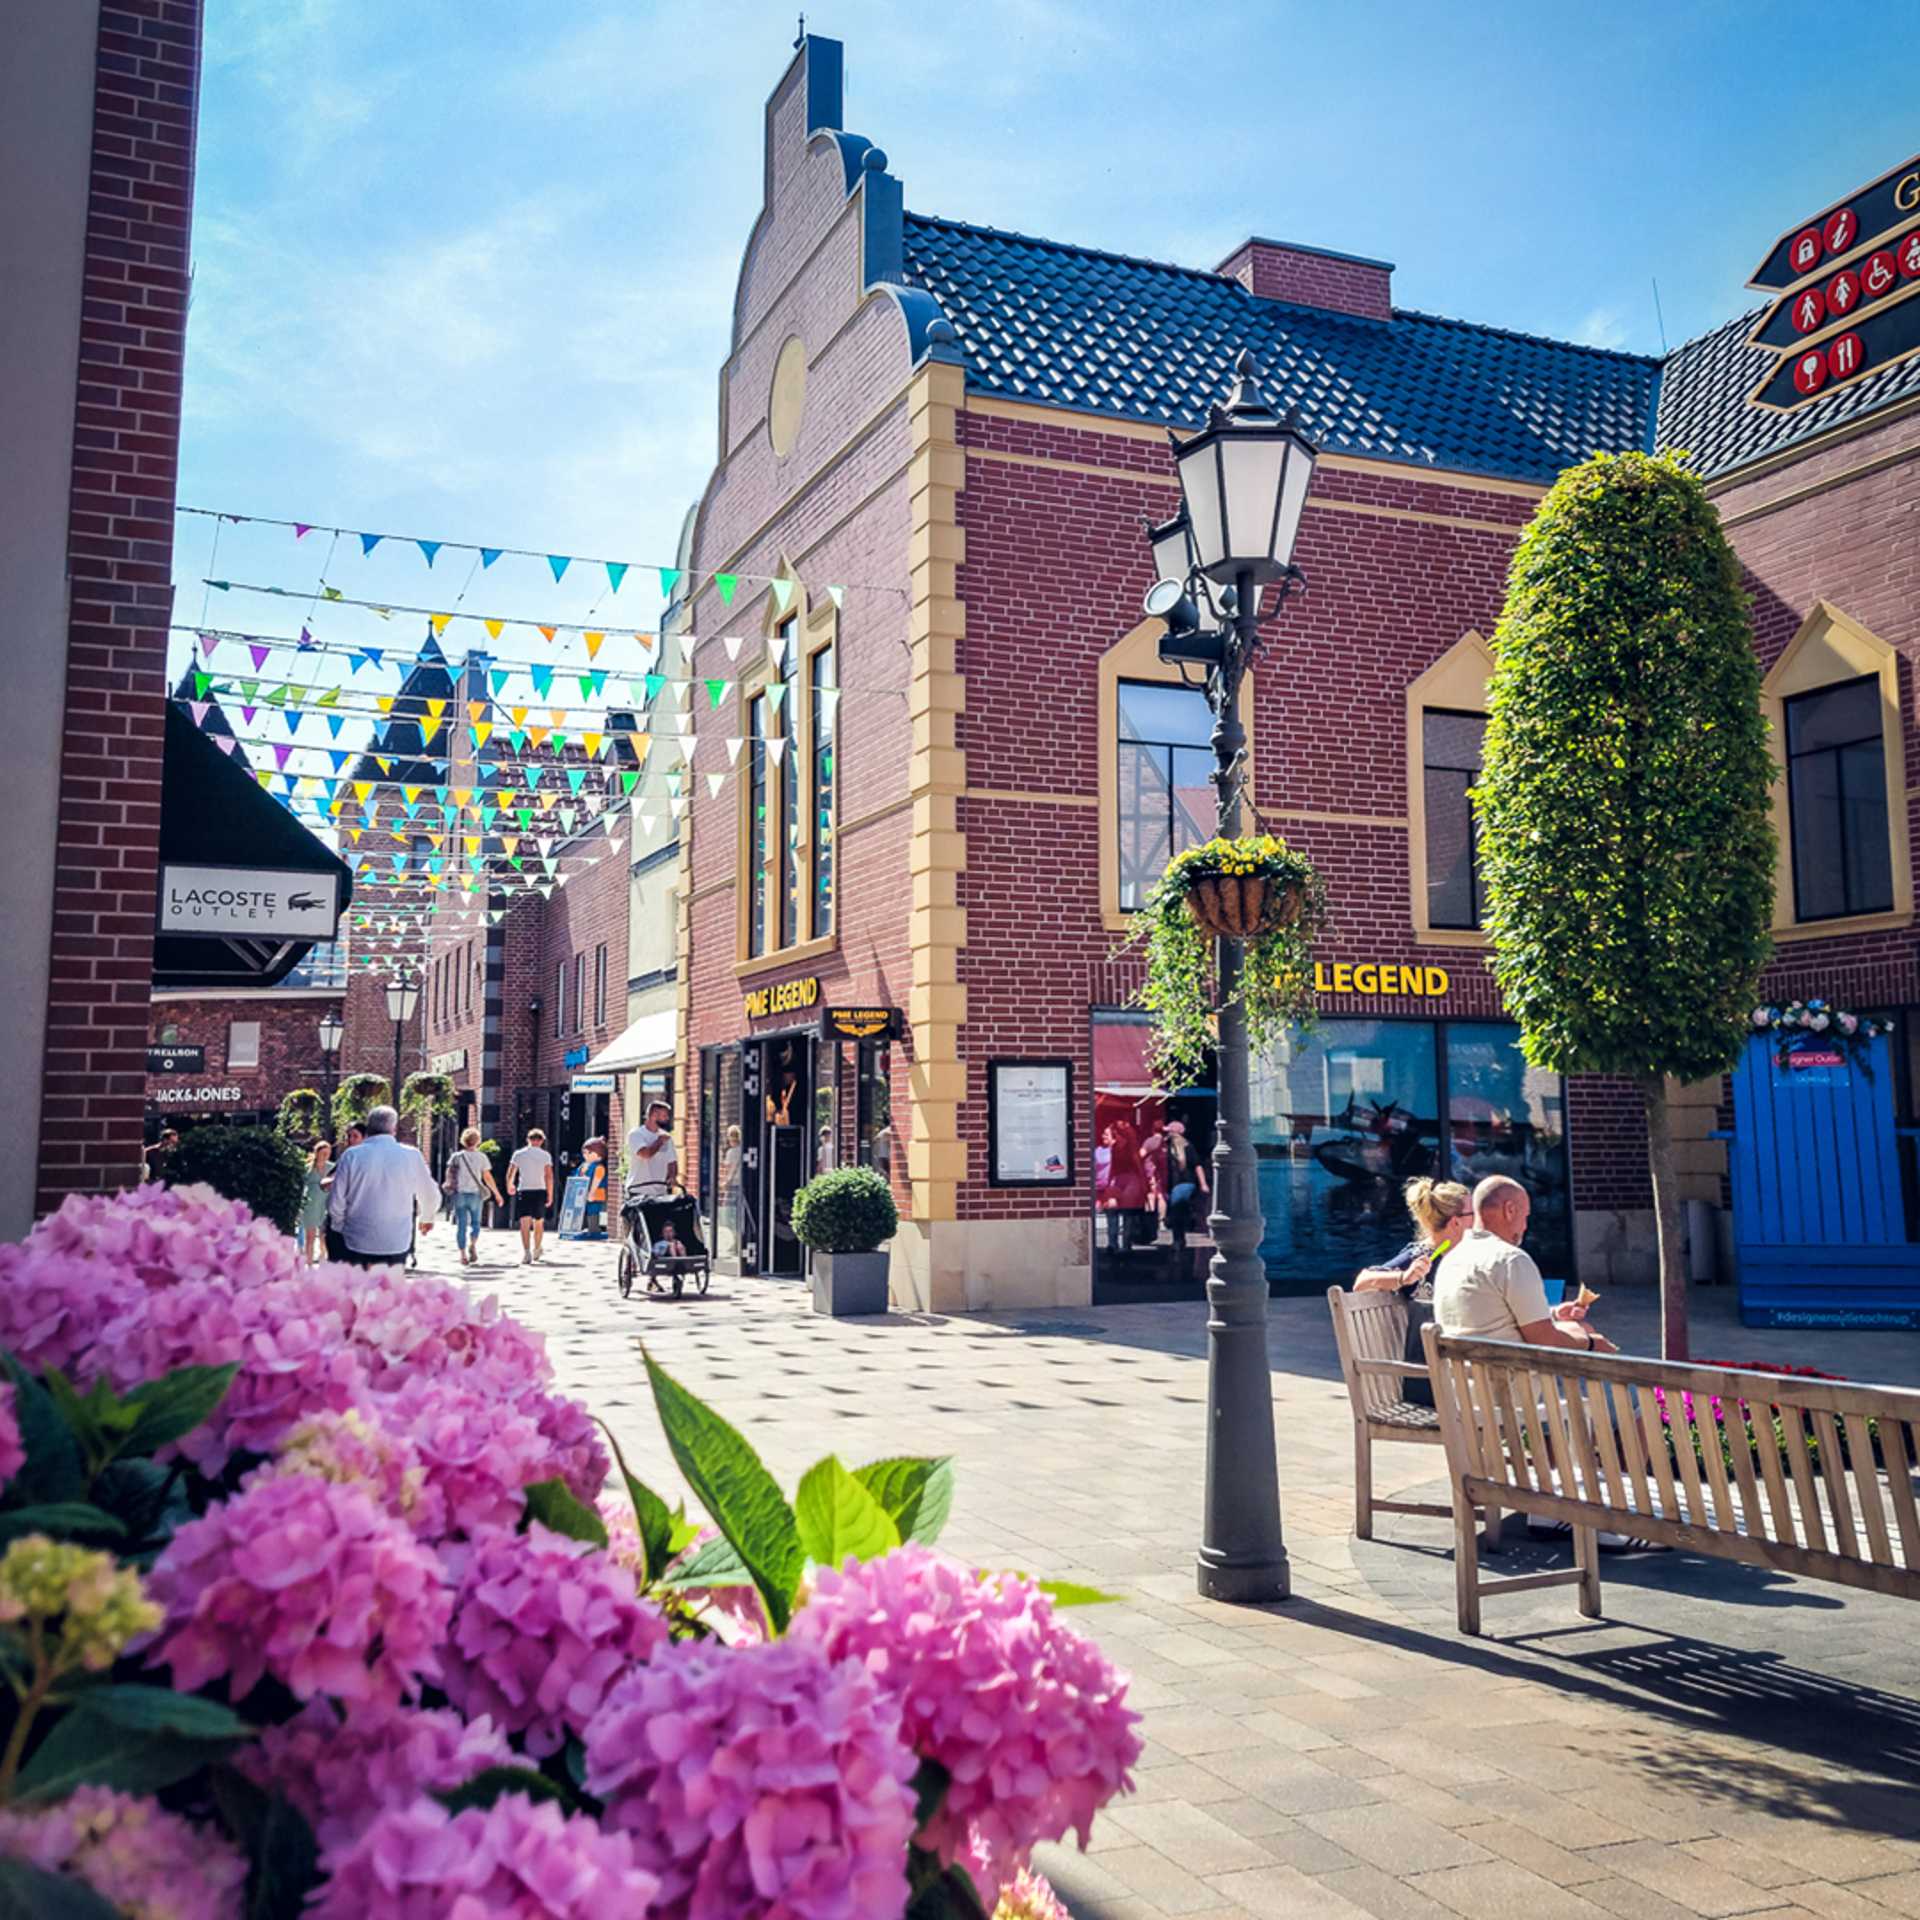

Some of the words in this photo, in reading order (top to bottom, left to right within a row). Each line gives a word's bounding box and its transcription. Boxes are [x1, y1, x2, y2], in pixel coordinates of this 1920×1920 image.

[171, 888, 277, 908] LACOSTE
[170, 904, 276, 919] OUTLET
[1314, 961, 1449, 996] LEGEND
[770, 976, 818, 1013] LEGEND
[853, 1010, 889, 1020] LEGEND
[155, 1087, 241, 1102] JACK&JONES
